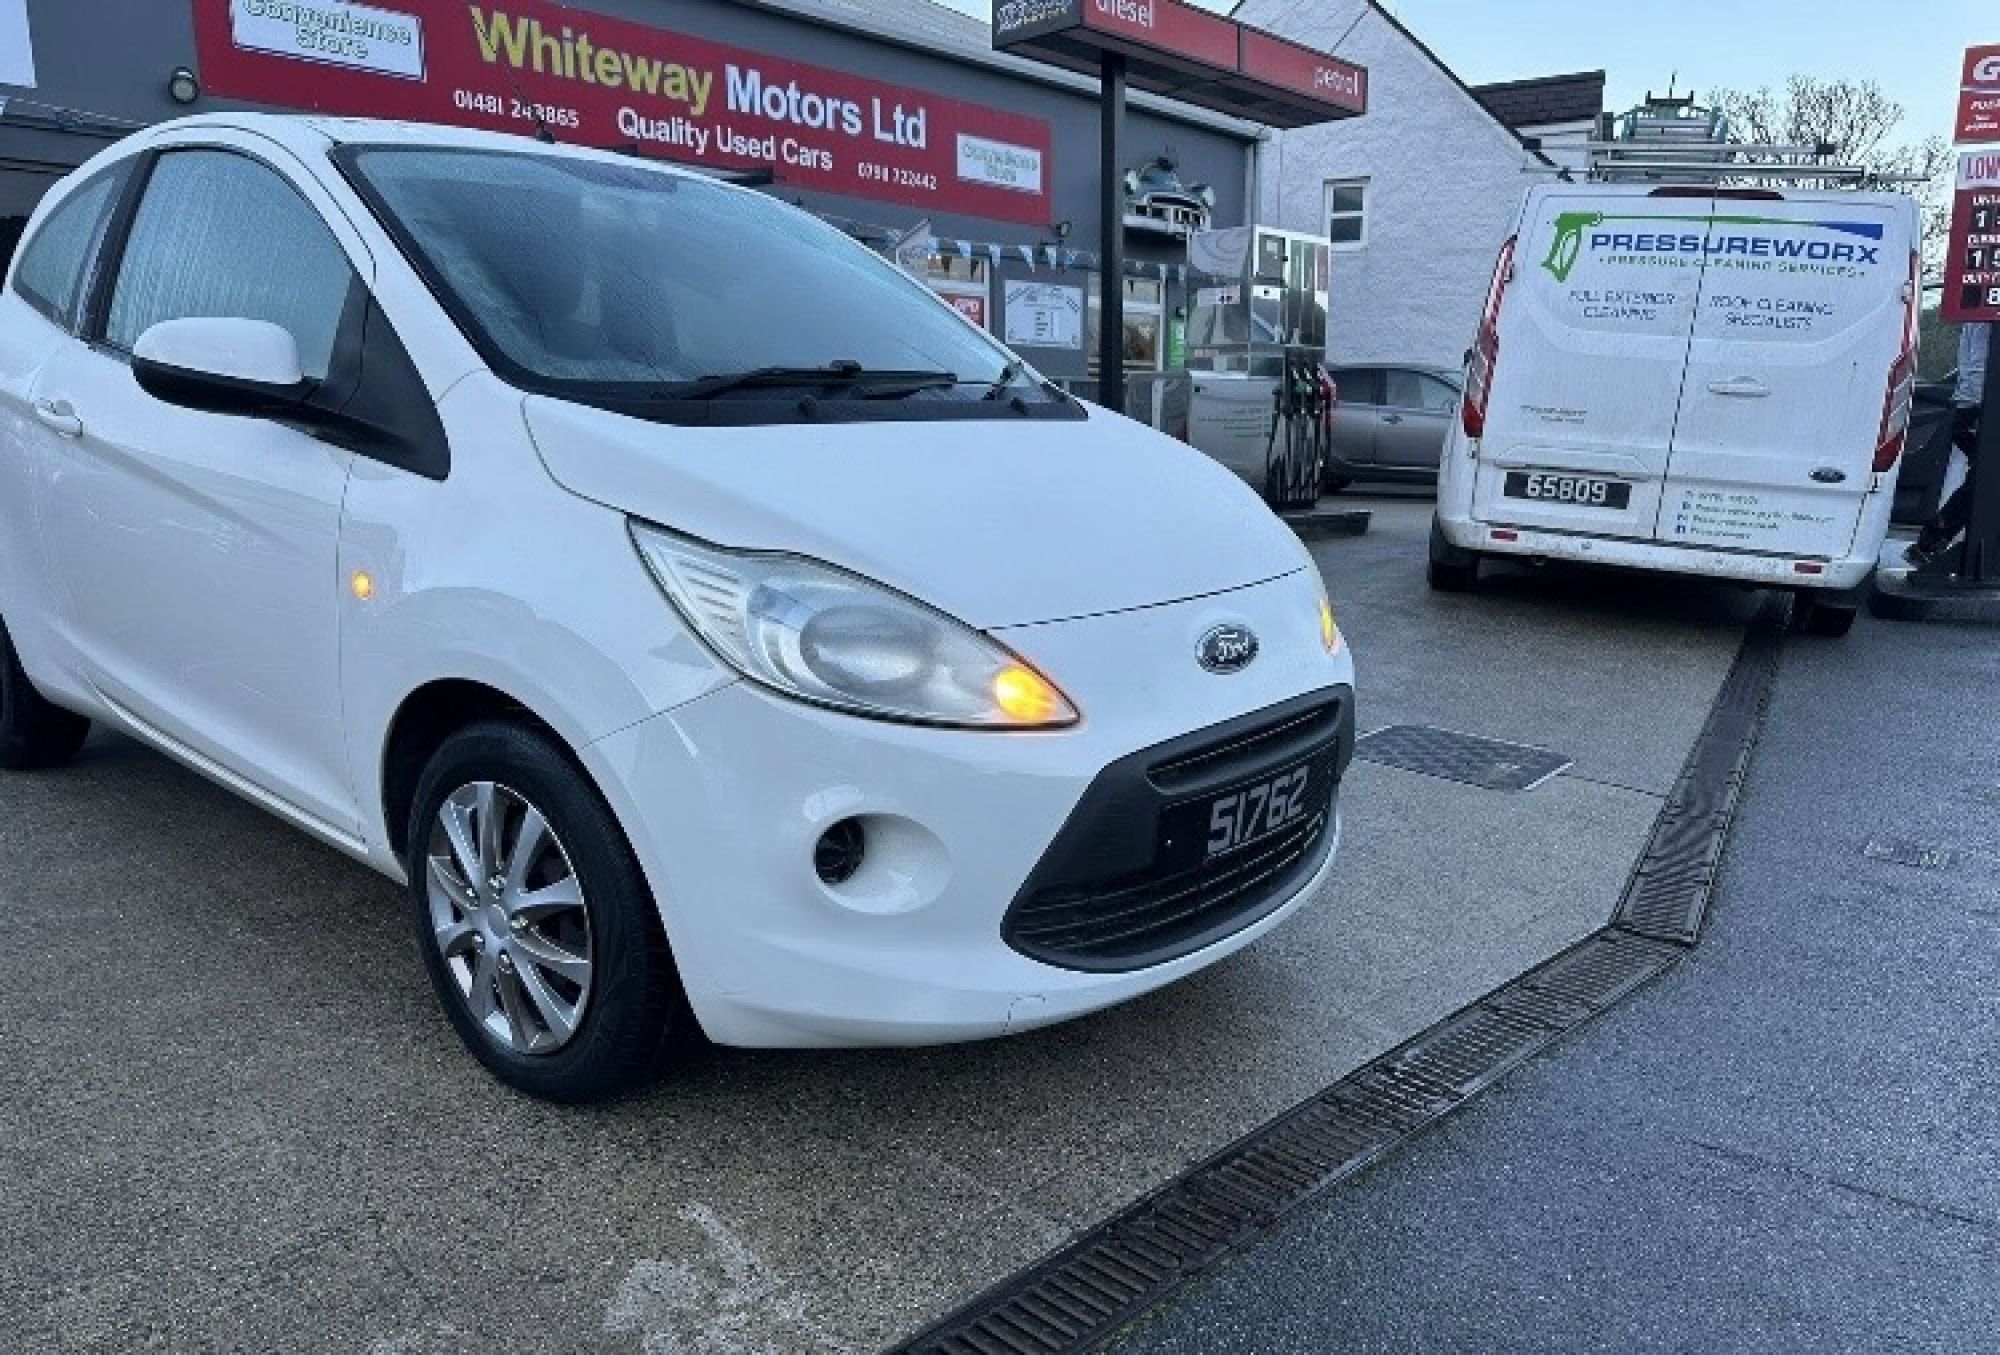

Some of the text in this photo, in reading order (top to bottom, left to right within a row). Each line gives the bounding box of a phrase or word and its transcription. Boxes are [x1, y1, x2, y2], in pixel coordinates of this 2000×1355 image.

[295, 28, 369, 60] Store
[470, 6, 927, 150] Whiteway Motors Ltd
[453, 88, 504, 116] 01481
[616, 107, 834, 171] Quality Used Cars
[1591, 234, 1879, 265] PRESSUREWORX
[1607, 255, 1857, 278] PRESSURE CLEANING SERVICES
[1527, 474, 1606, 502] 65809
[1207, 765, 1309, 857] 51762
